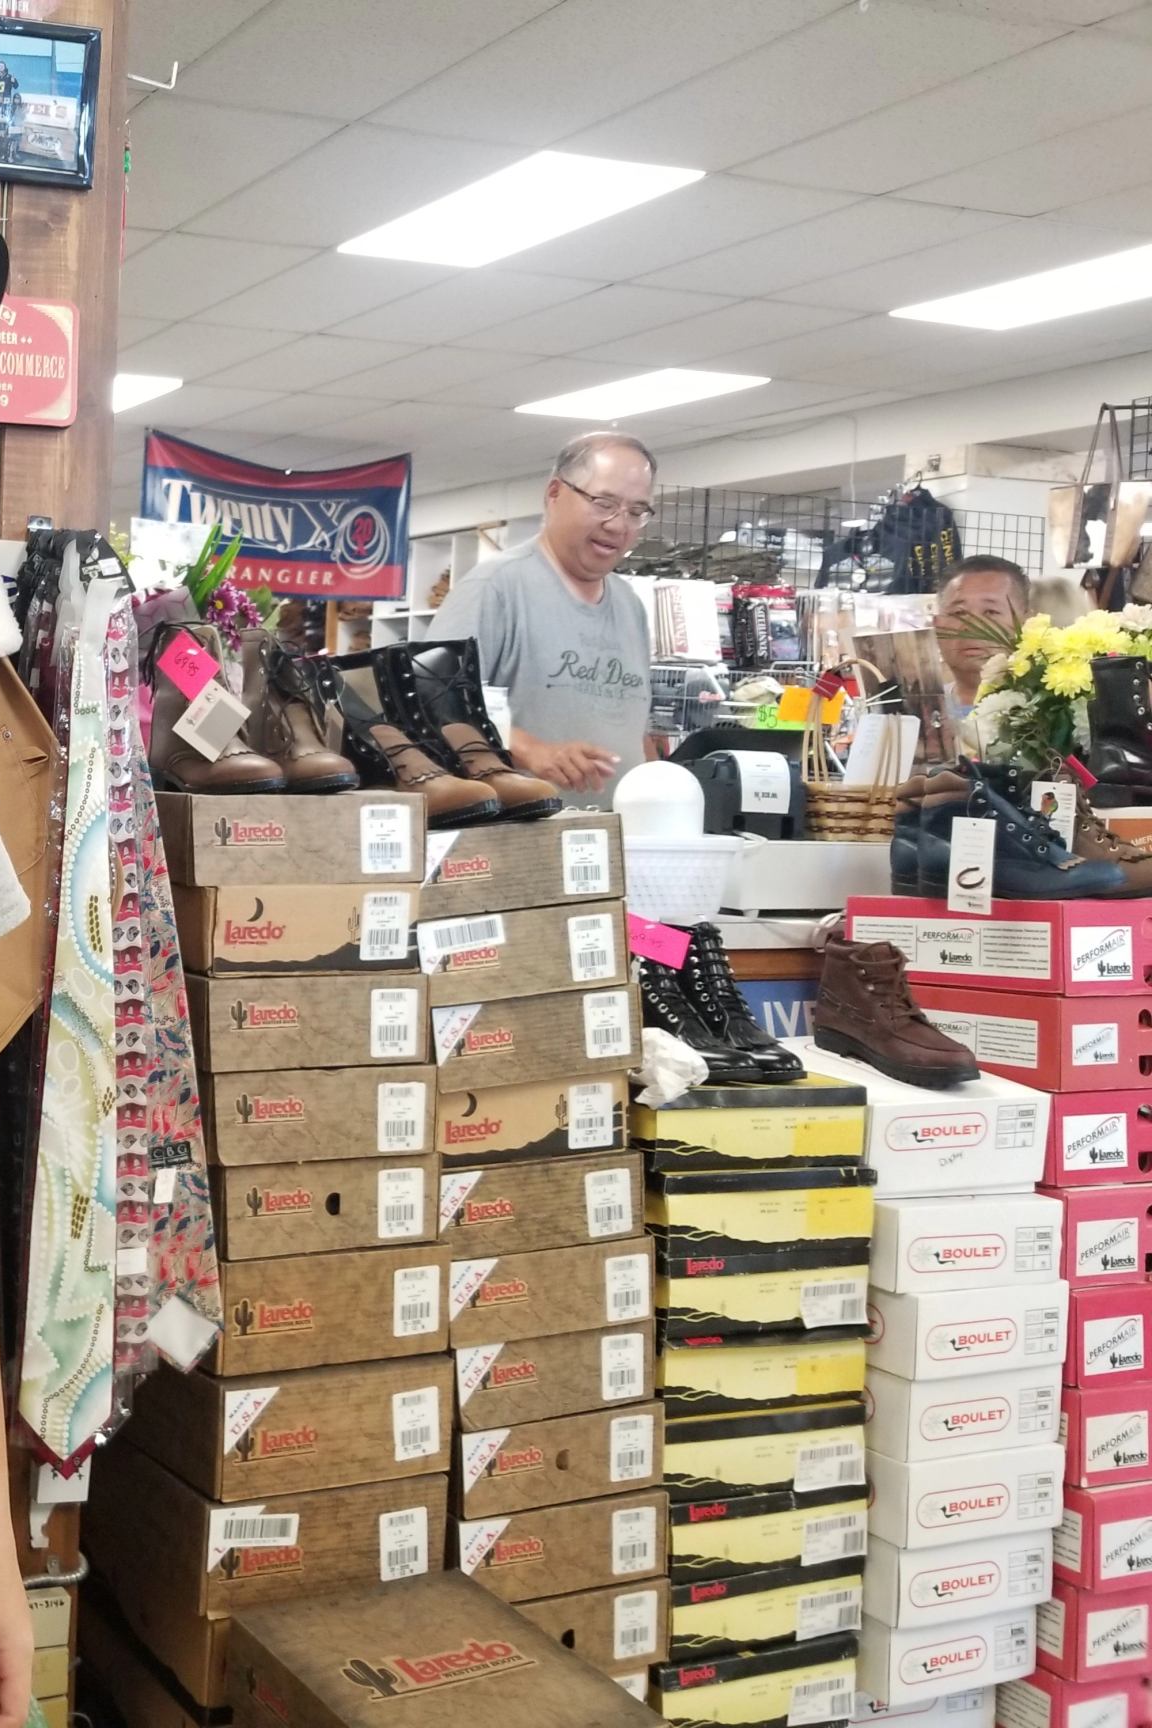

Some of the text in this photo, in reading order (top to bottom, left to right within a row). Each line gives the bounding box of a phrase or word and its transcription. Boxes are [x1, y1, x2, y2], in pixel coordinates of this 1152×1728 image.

[0, 352, 66, 379] COMMERCE
[205, 562, 335, 586] RANGLER
[548, 650, 644, 687] Red Deer
[232, 822, 283, 842] Laredo
[444, 857, 489, 879] Laredo
[224, 920, 283, 945] Laredo
[949, 952, 972, 962] Laredo
[1076, 935, 1126, 966] PERFORMAIR
[1106, 961, 1131, 975] Laredo
[250, 1004, 297, 1025] Laredo
[466, 1028, 512, 1051] Laredo
[254, 1098, 302, 1119] Laredo
[445, 1118, 499, 1144] Laredo
[921, 1124, 981, 1138] BOULET
[1066, 1120, 1119, 1153] PERFORMAIR
[1098, 1148, 1124, 1161] Laredo
[264, 1190, 310, 1212] Laredo
[467, 1200, 513, 1222] Laredo
[943, 1247, 1000, 1259] BOULET
[1080, 1227, 1130, 1261] PERFORMAIR
[686, 1256, 724, 1275] Laredo
[1110, 1256, 1136, 1268] Laredo
[259, 1301, 314, 1329] Laredo
[958, 1331, 1012, 1346] BOULET
[1089, 1326, 1137, 1360] PERFORMAIR
[1118, 1352, 1142, 1365] Laredo
[491, 1361, 536, 1384] Laredo
[951, 1409, 1005, 1425] BOULET
[260, 1426, 317, 1455] Laredo
[499, 1448, 542, 1471] Laredo
[949, 1496, 1003, 1513] BOULET
[241, 1547, 302, 1573] Laredo
[941, 1574, 995, 1591] BOULET
[393, 1641, 513, 1683] Laredo
[442, 1654, 523, 1679] WESTERN BOOTS
[930, 1648, 981, 1667] BOULET
